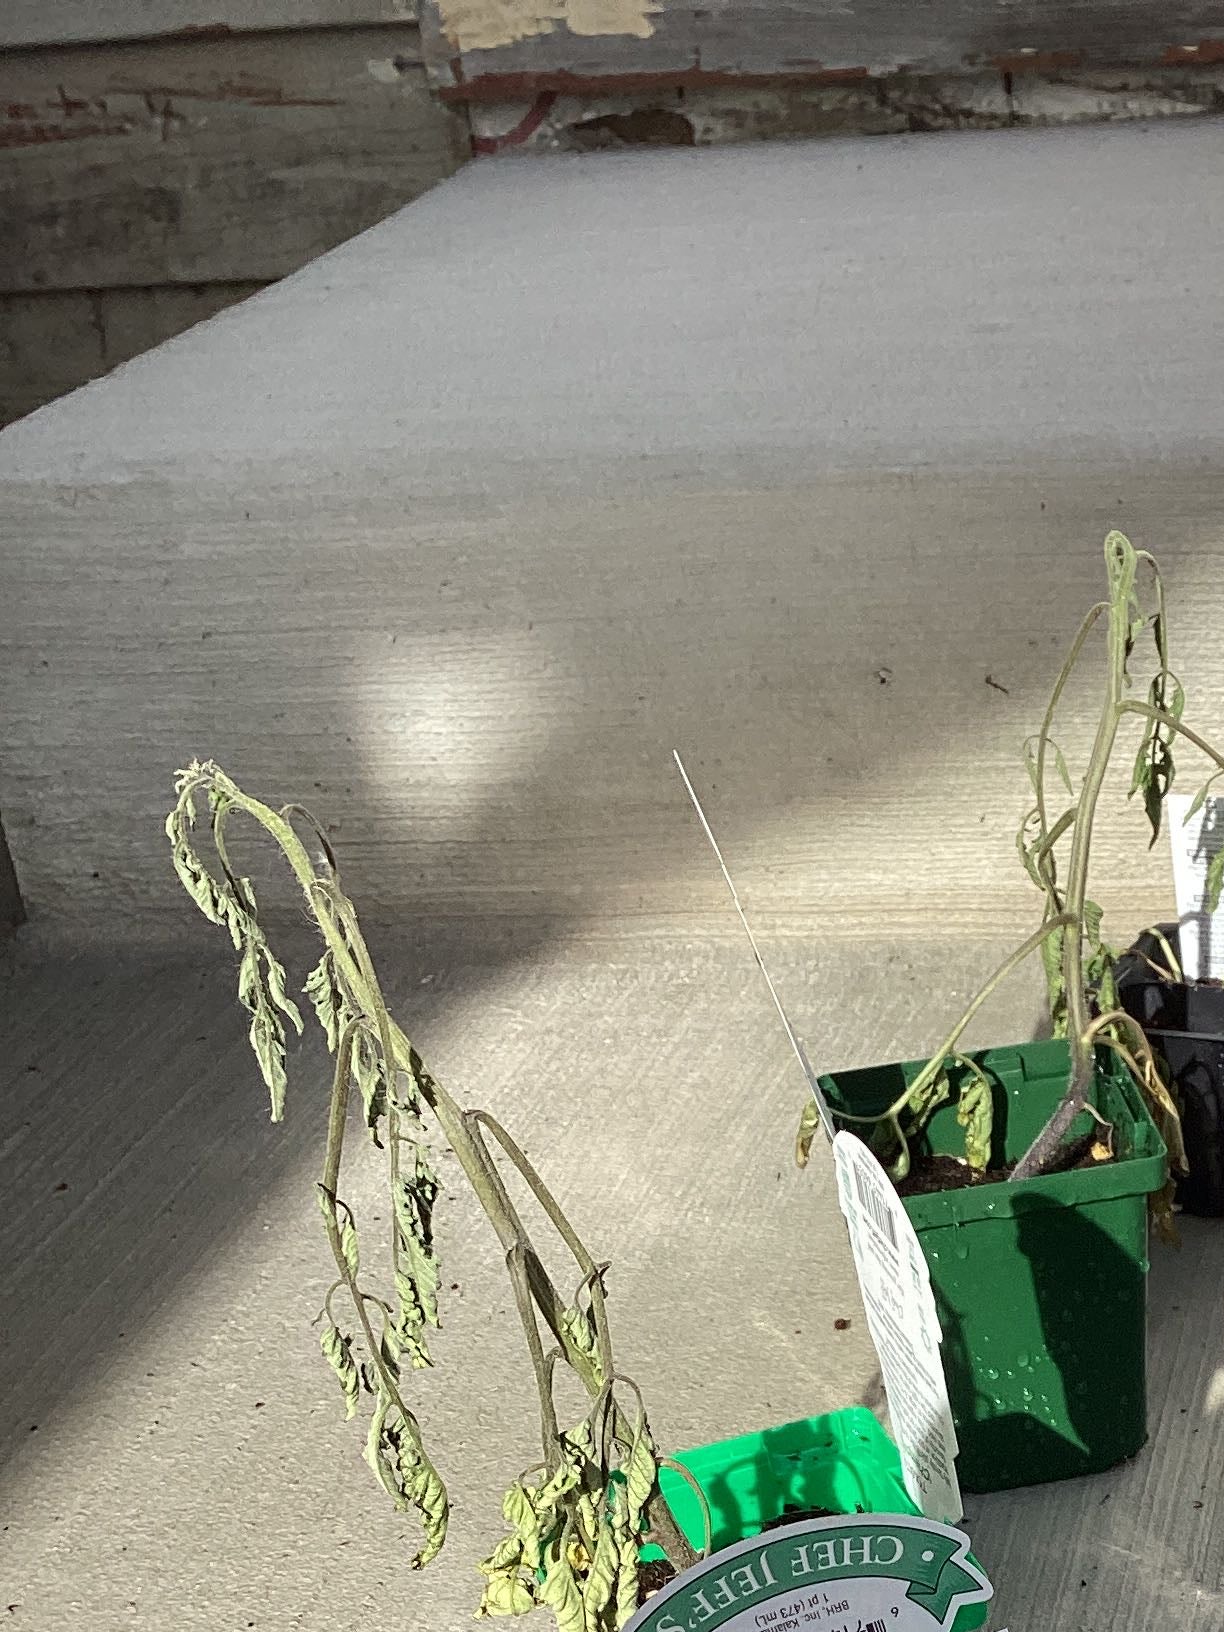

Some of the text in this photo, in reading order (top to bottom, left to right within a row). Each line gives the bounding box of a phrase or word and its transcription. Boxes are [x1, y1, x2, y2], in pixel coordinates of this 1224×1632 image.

[790, 1535, 903, 1576] CHEF
[778, 1599, 805, 1619] (473
[806, 1593, 820, 1608] pt
[889, 1605, 899, 1618] 6
